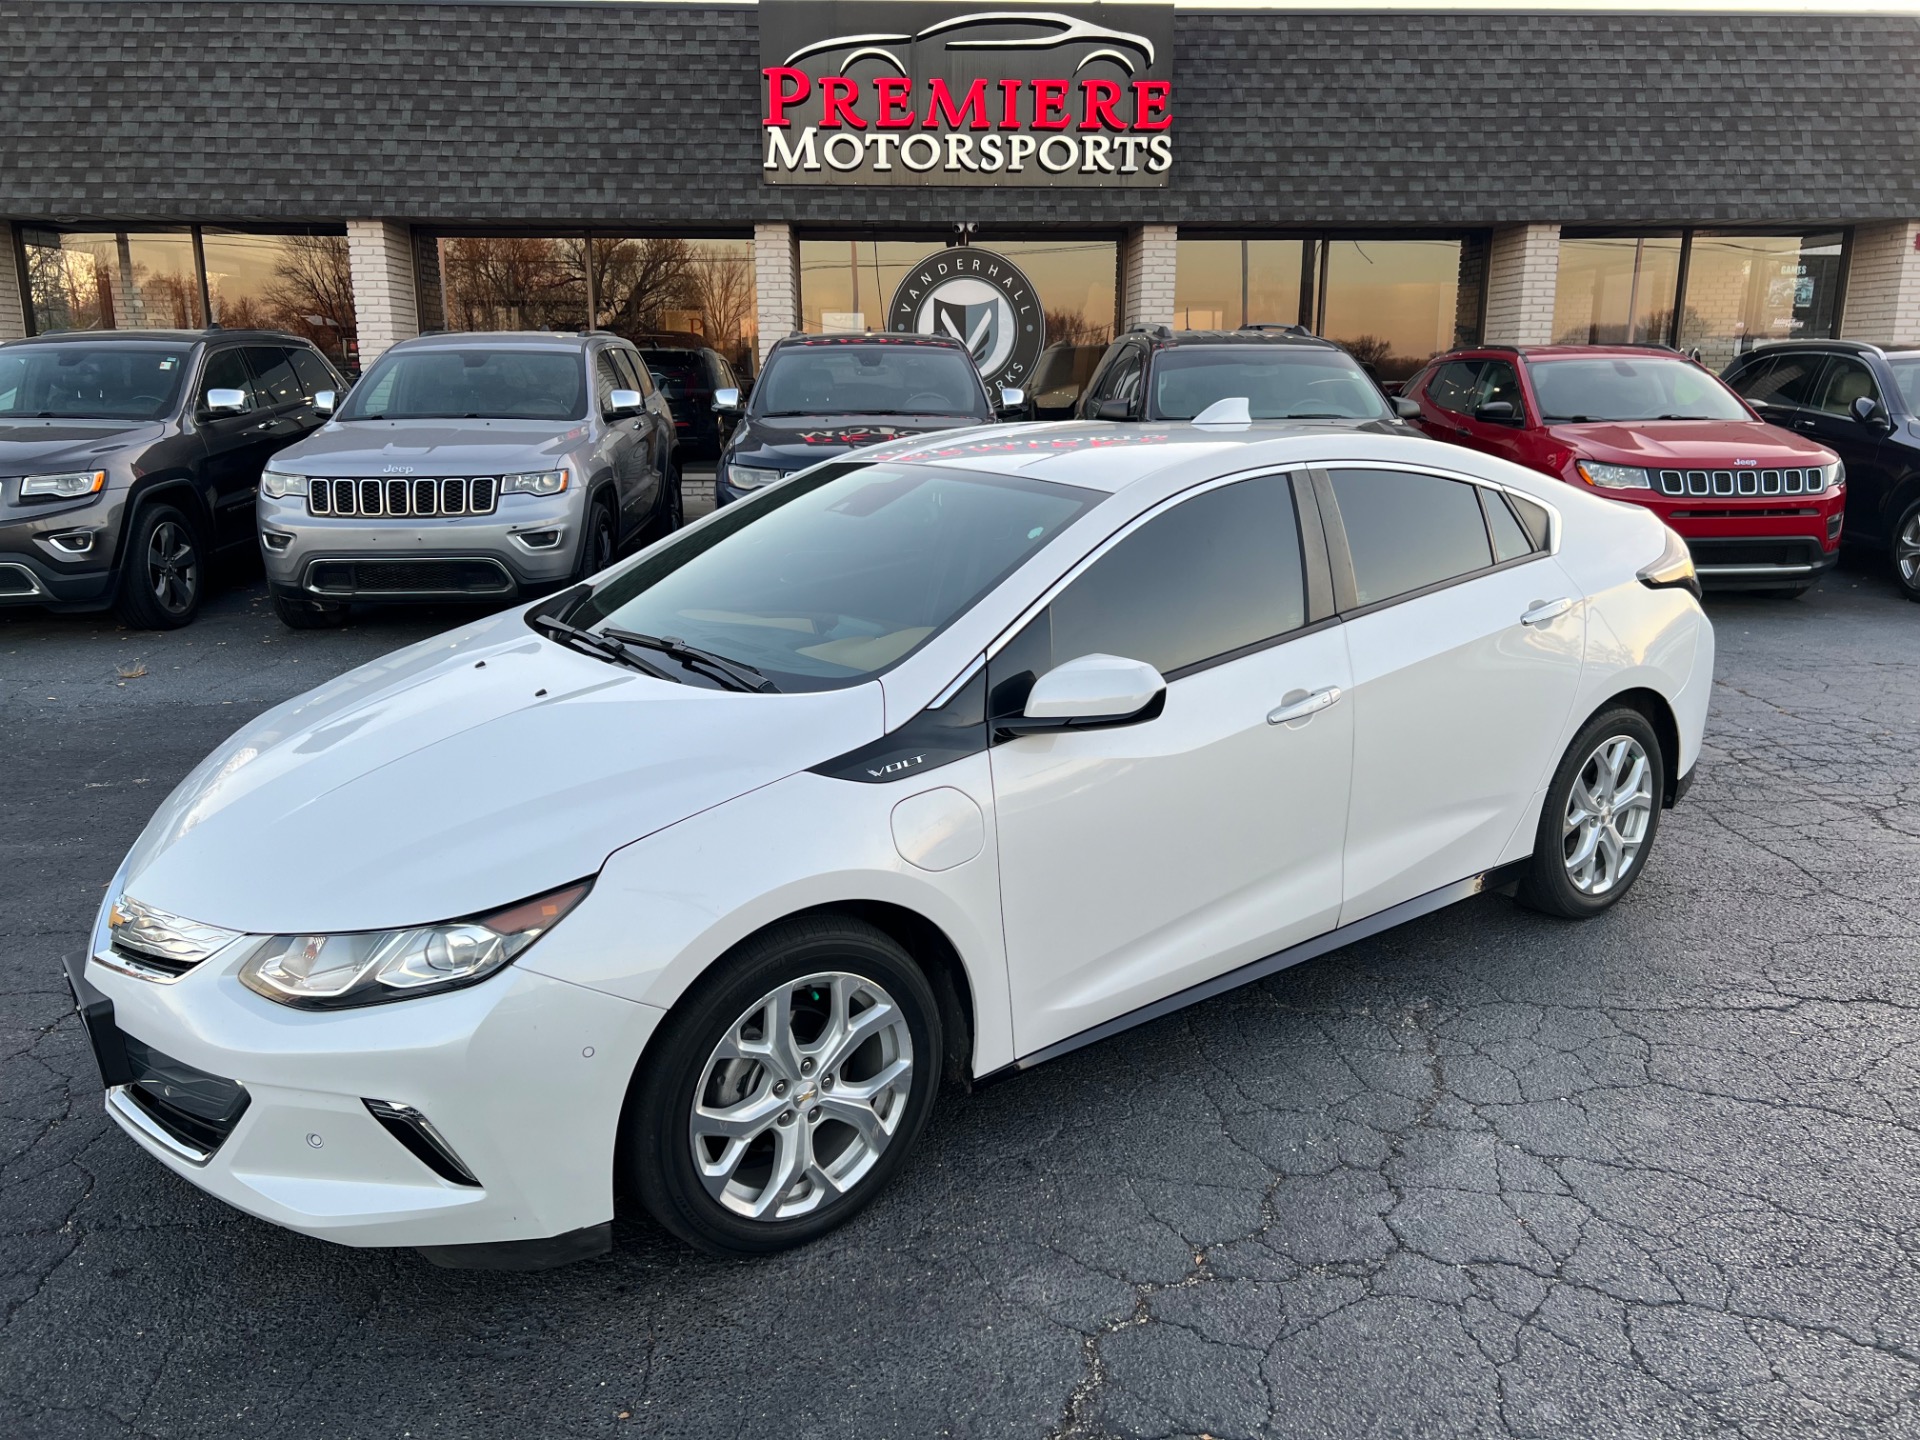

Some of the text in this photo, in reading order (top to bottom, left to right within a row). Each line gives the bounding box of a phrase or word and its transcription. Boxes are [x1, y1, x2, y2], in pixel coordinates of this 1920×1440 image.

[763, 67, 1173, 130] PREMIERE
[764, 126, 1173, 172] MOTORSPORTS
[1781, 265, 1807, 275] GAMES
[901, 259, 1031, 315] VANDERHALL
[383, 464, 413, 474] Jeep
[1734, 458, 1757, 466] Jeep
[866, 753, 926, 777] VOLT
